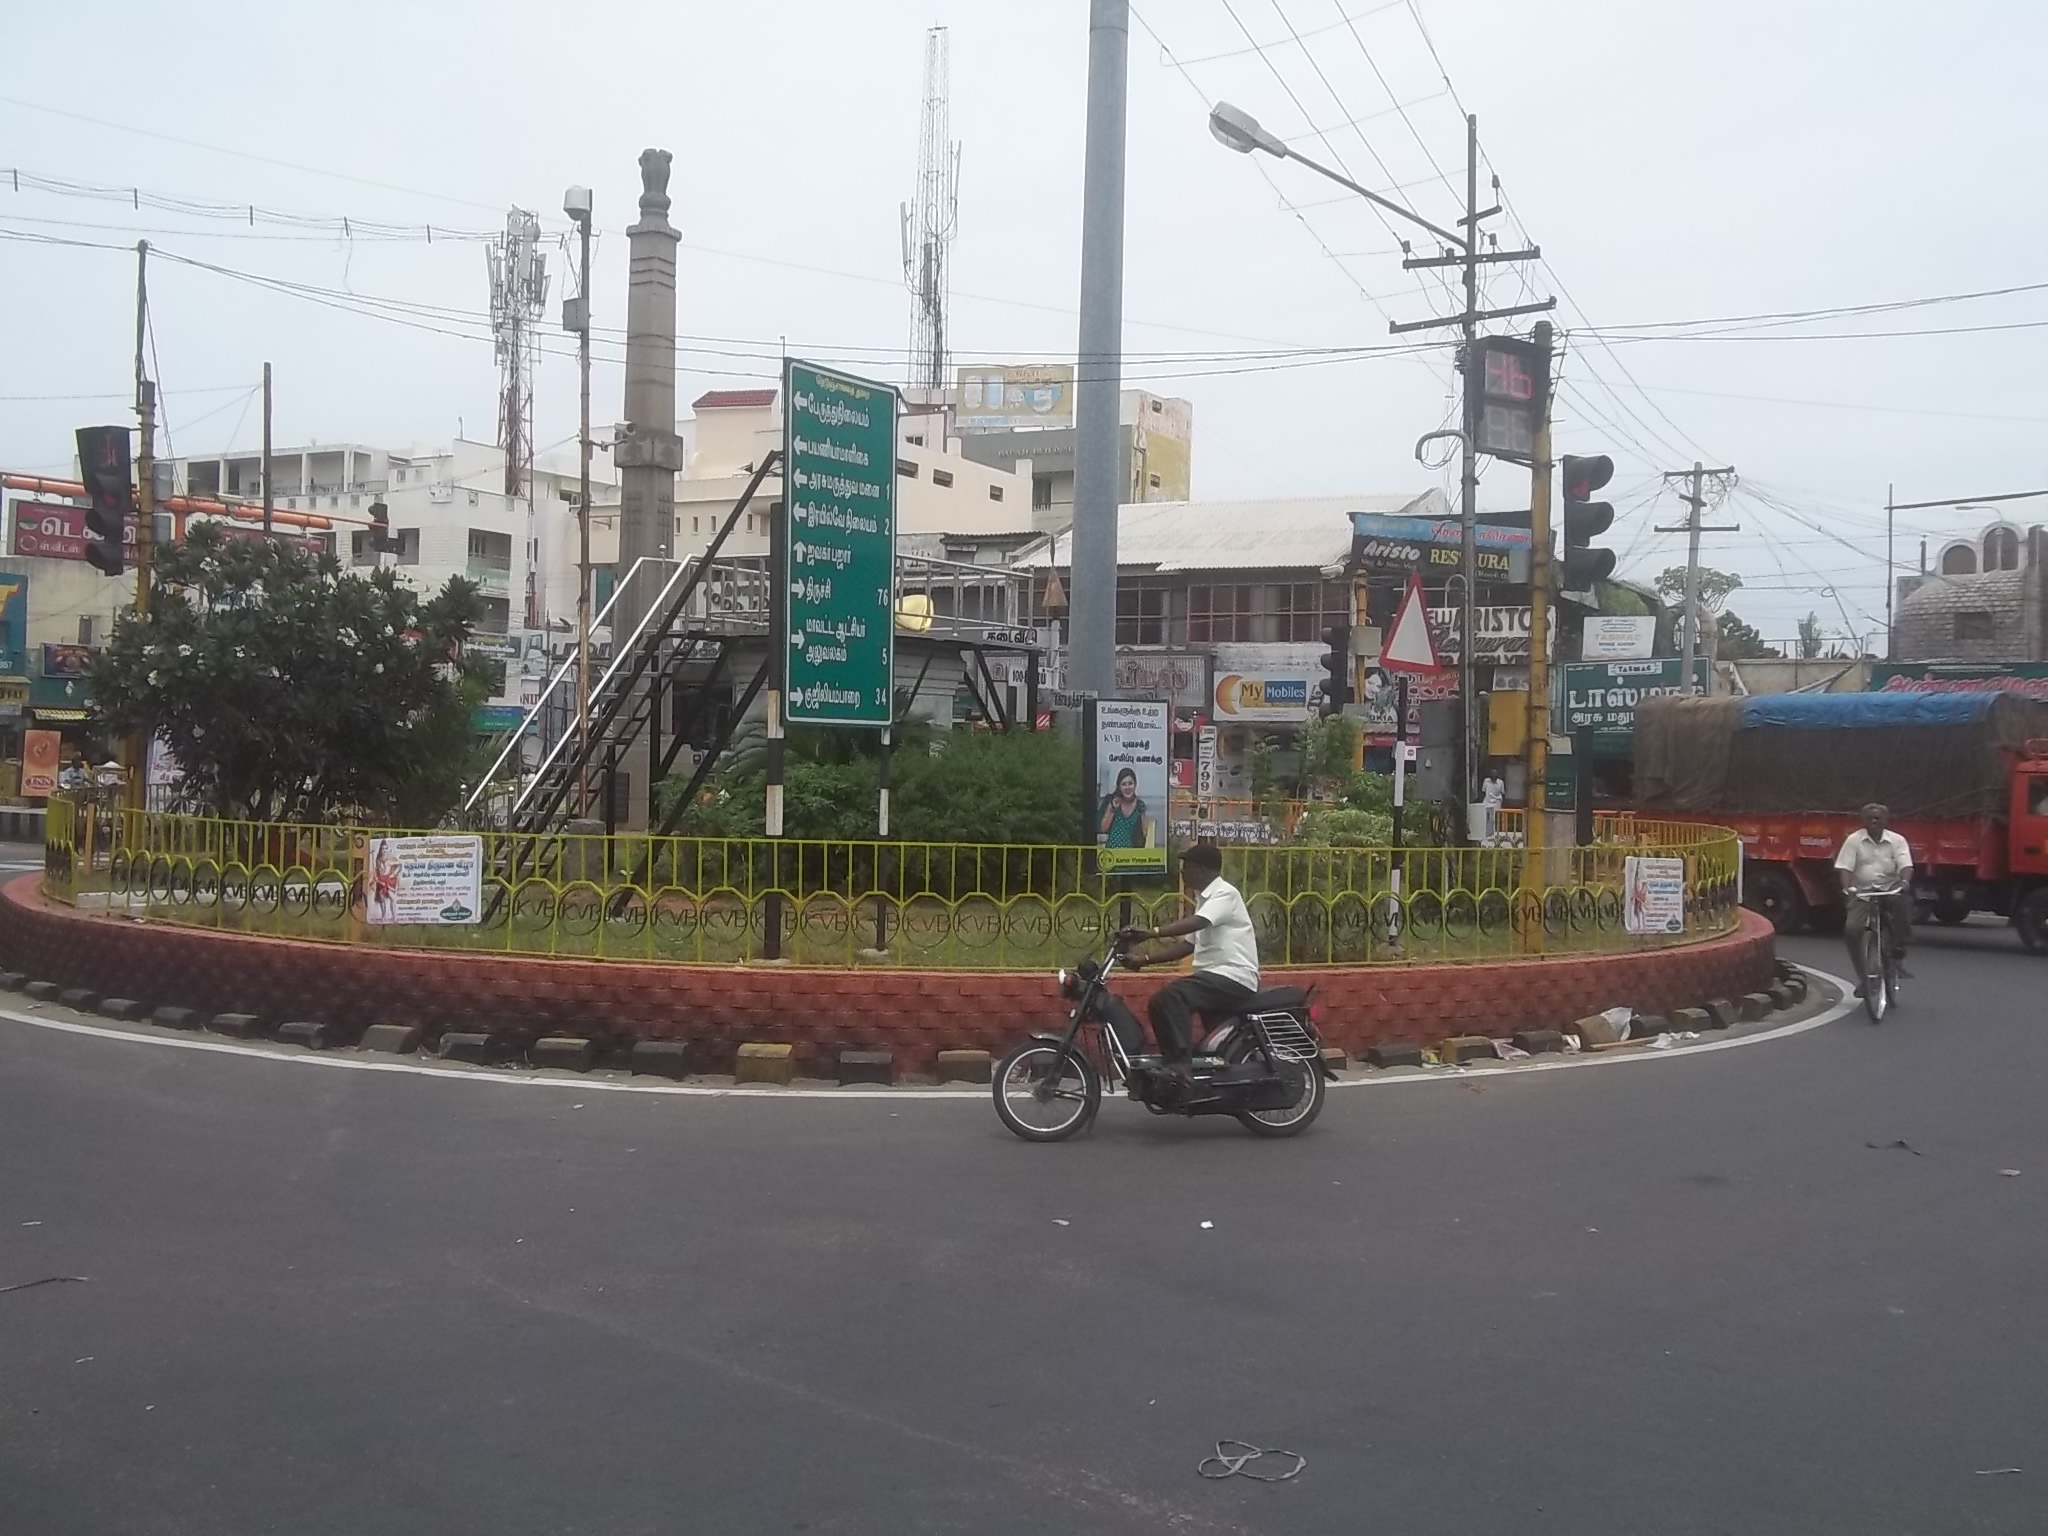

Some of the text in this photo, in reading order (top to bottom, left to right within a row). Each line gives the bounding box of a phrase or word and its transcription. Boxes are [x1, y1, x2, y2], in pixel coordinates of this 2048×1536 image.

[886, 483, 890, 500] 1
[884, 518, 890, 536] 2
[1363, 540, 1421, 561] Aristo
[877, 588, 889, 606] 76
[882, 648, 887, 665] 5
[875, 688, 887, 706] 34
[1241, 683, 1305, 700] My Mobiles
[1571, 711, 1635, 726] அரசு மது
[1104, 733, 1121, 743] KVB
[514, 899, 555, 918] KVB
[560, 903, 600, 921] KVB
[652, 907, 698, 927] KVB
[704, 911, 749, 929] KVB
[753, 911, 798, 931] KB
[804, 913, 848, 932] KVB
[906, 914, 950, 933] KVB
[957, 915, 1000, 934] KVB
[1008, 915, 1050, 934] KVB
